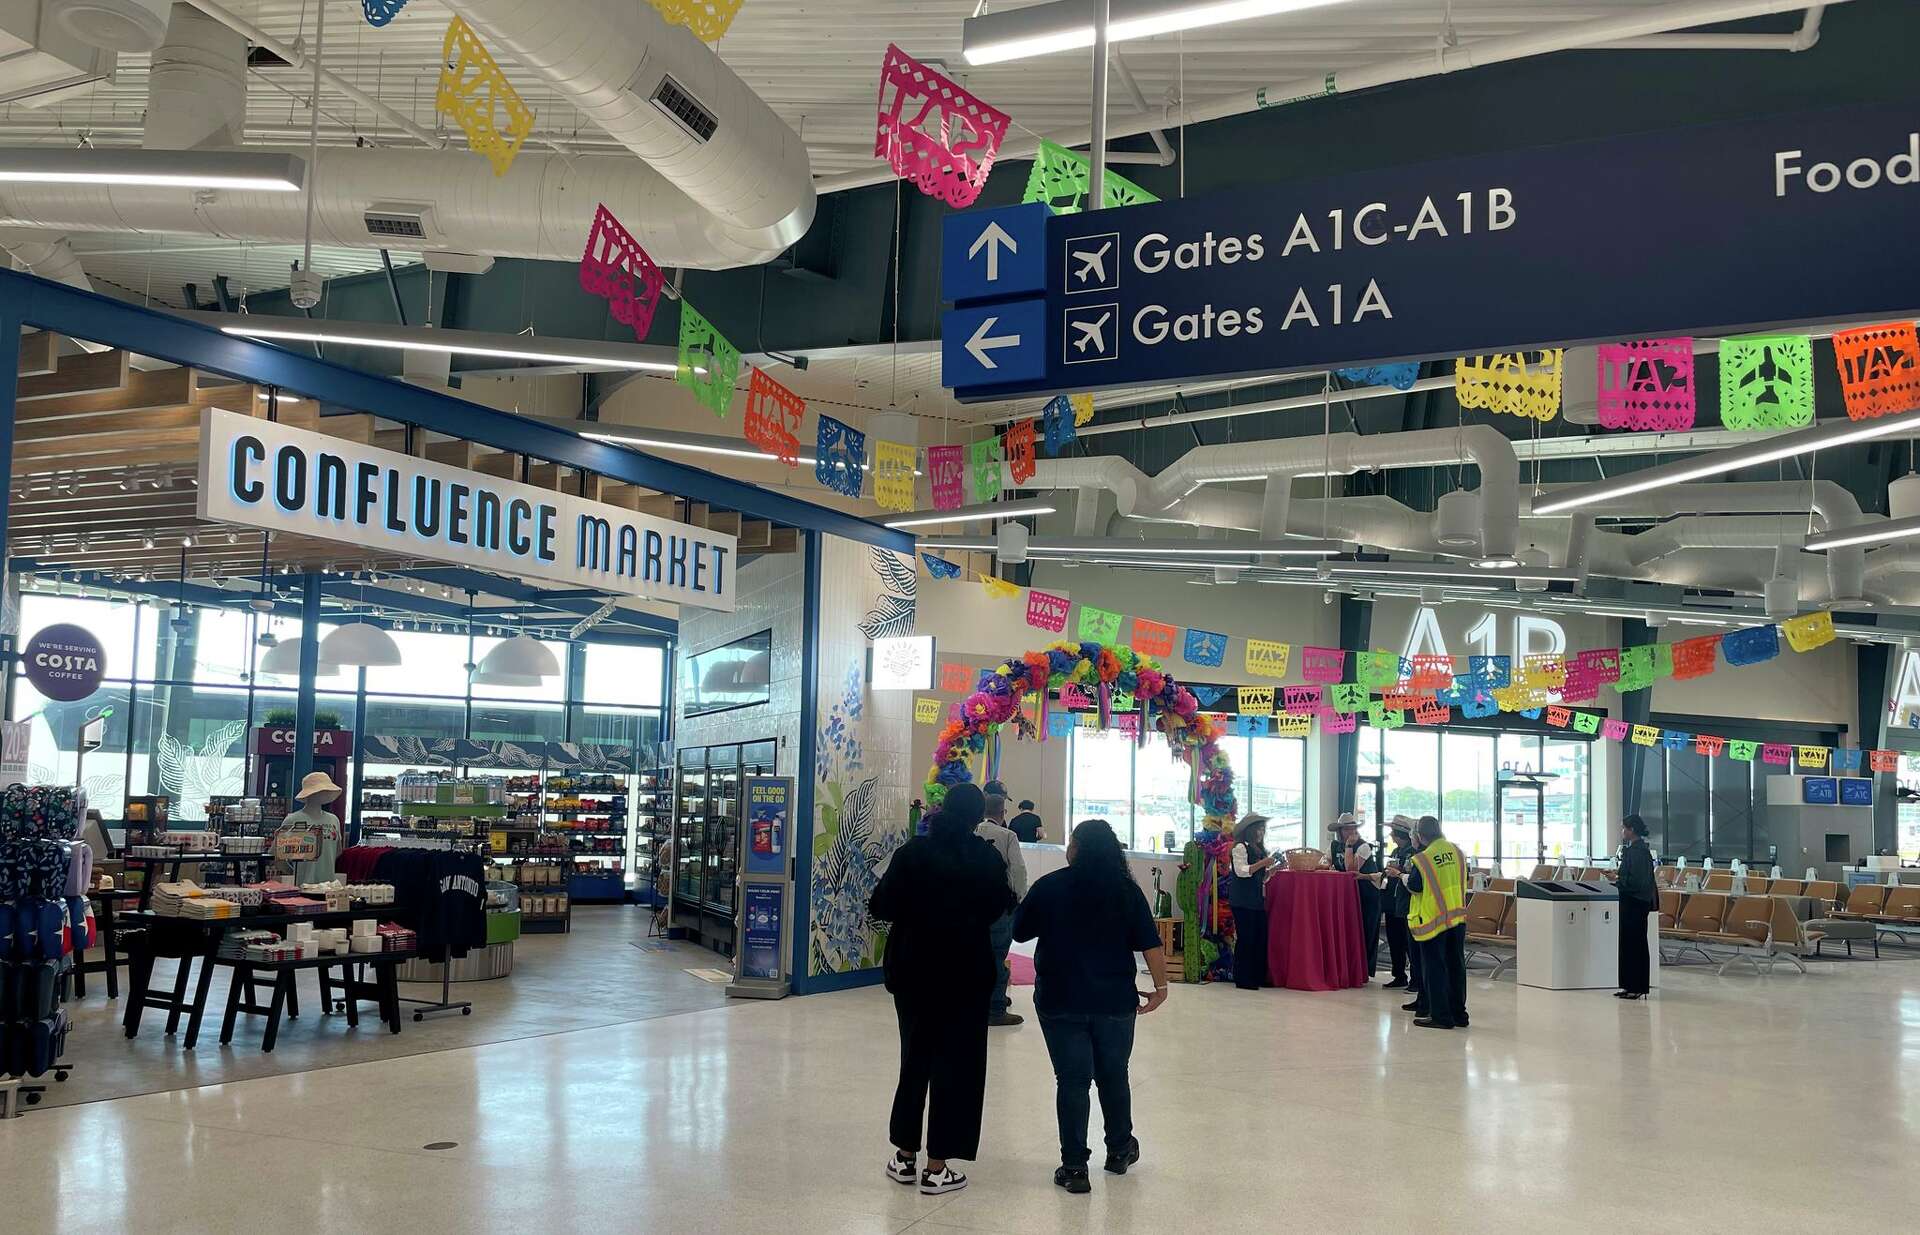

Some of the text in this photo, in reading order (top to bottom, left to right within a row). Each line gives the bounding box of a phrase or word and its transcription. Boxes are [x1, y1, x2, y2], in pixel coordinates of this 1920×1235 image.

[1775, 132, 1919, 197] Food
[1133, 188, 1516, 274] Gates A1C-A1B
[1132, 277, 1393, 345] Gates A1A
[232, 435, 729, 594] CONFLUENCE MARKET
[39, 642, 97, 654] WE'RE SERVING
[35, 653, 98, 672] COSTA
[48, 671, 83, 680] COFFEE
[271, 730, 333, 745] COTA
[752, 786, 785, 794] FEEL GOOD
[752, 795, 785, 803] ON THE GO
[1433, 852, 1453, 865] SAT
[440, 874, 479, 897] SAN ANTONIO
